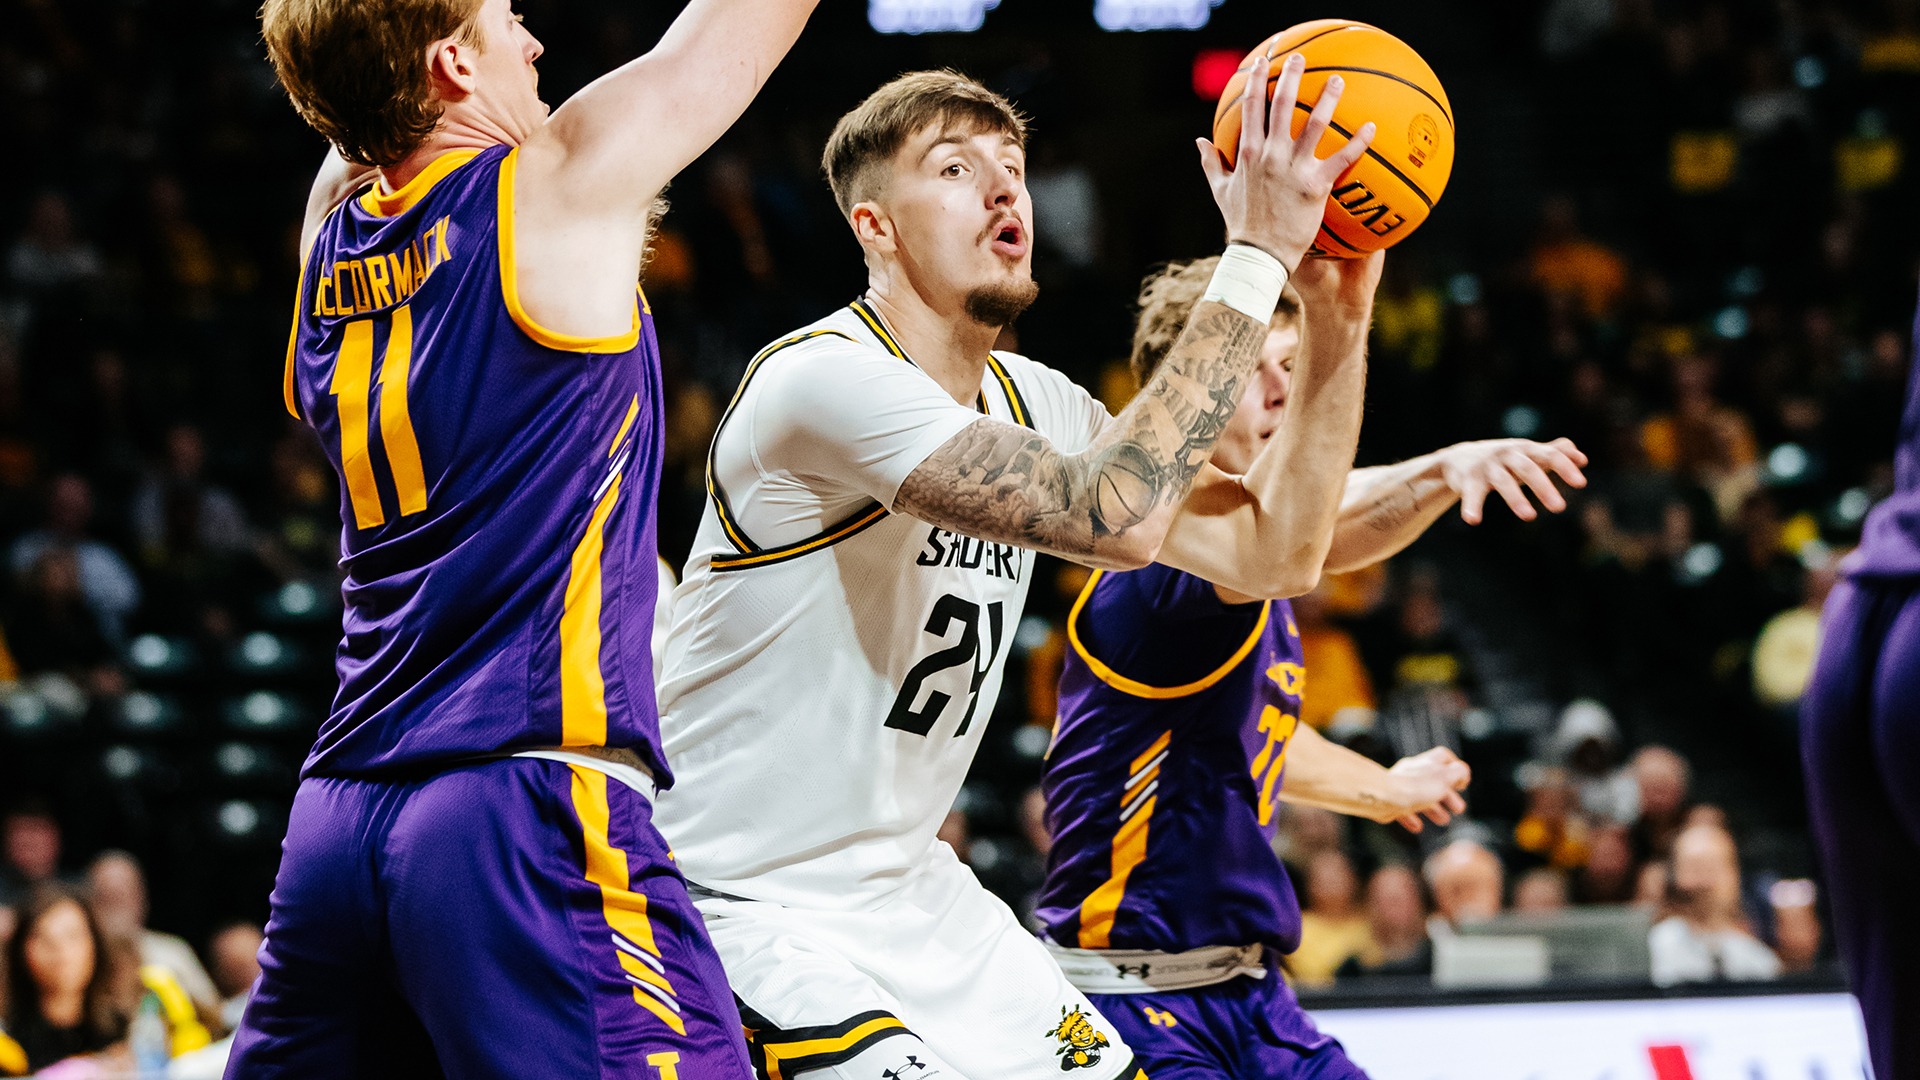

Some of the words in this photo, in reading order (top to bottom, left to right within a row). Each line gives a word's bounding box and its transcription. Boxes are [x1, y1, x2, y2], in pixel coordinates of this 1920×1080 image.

[1330, 179, 1406, 237] EVO
[329, 304, 427, 530] 11
[883, 593, 1004, 738] 24
